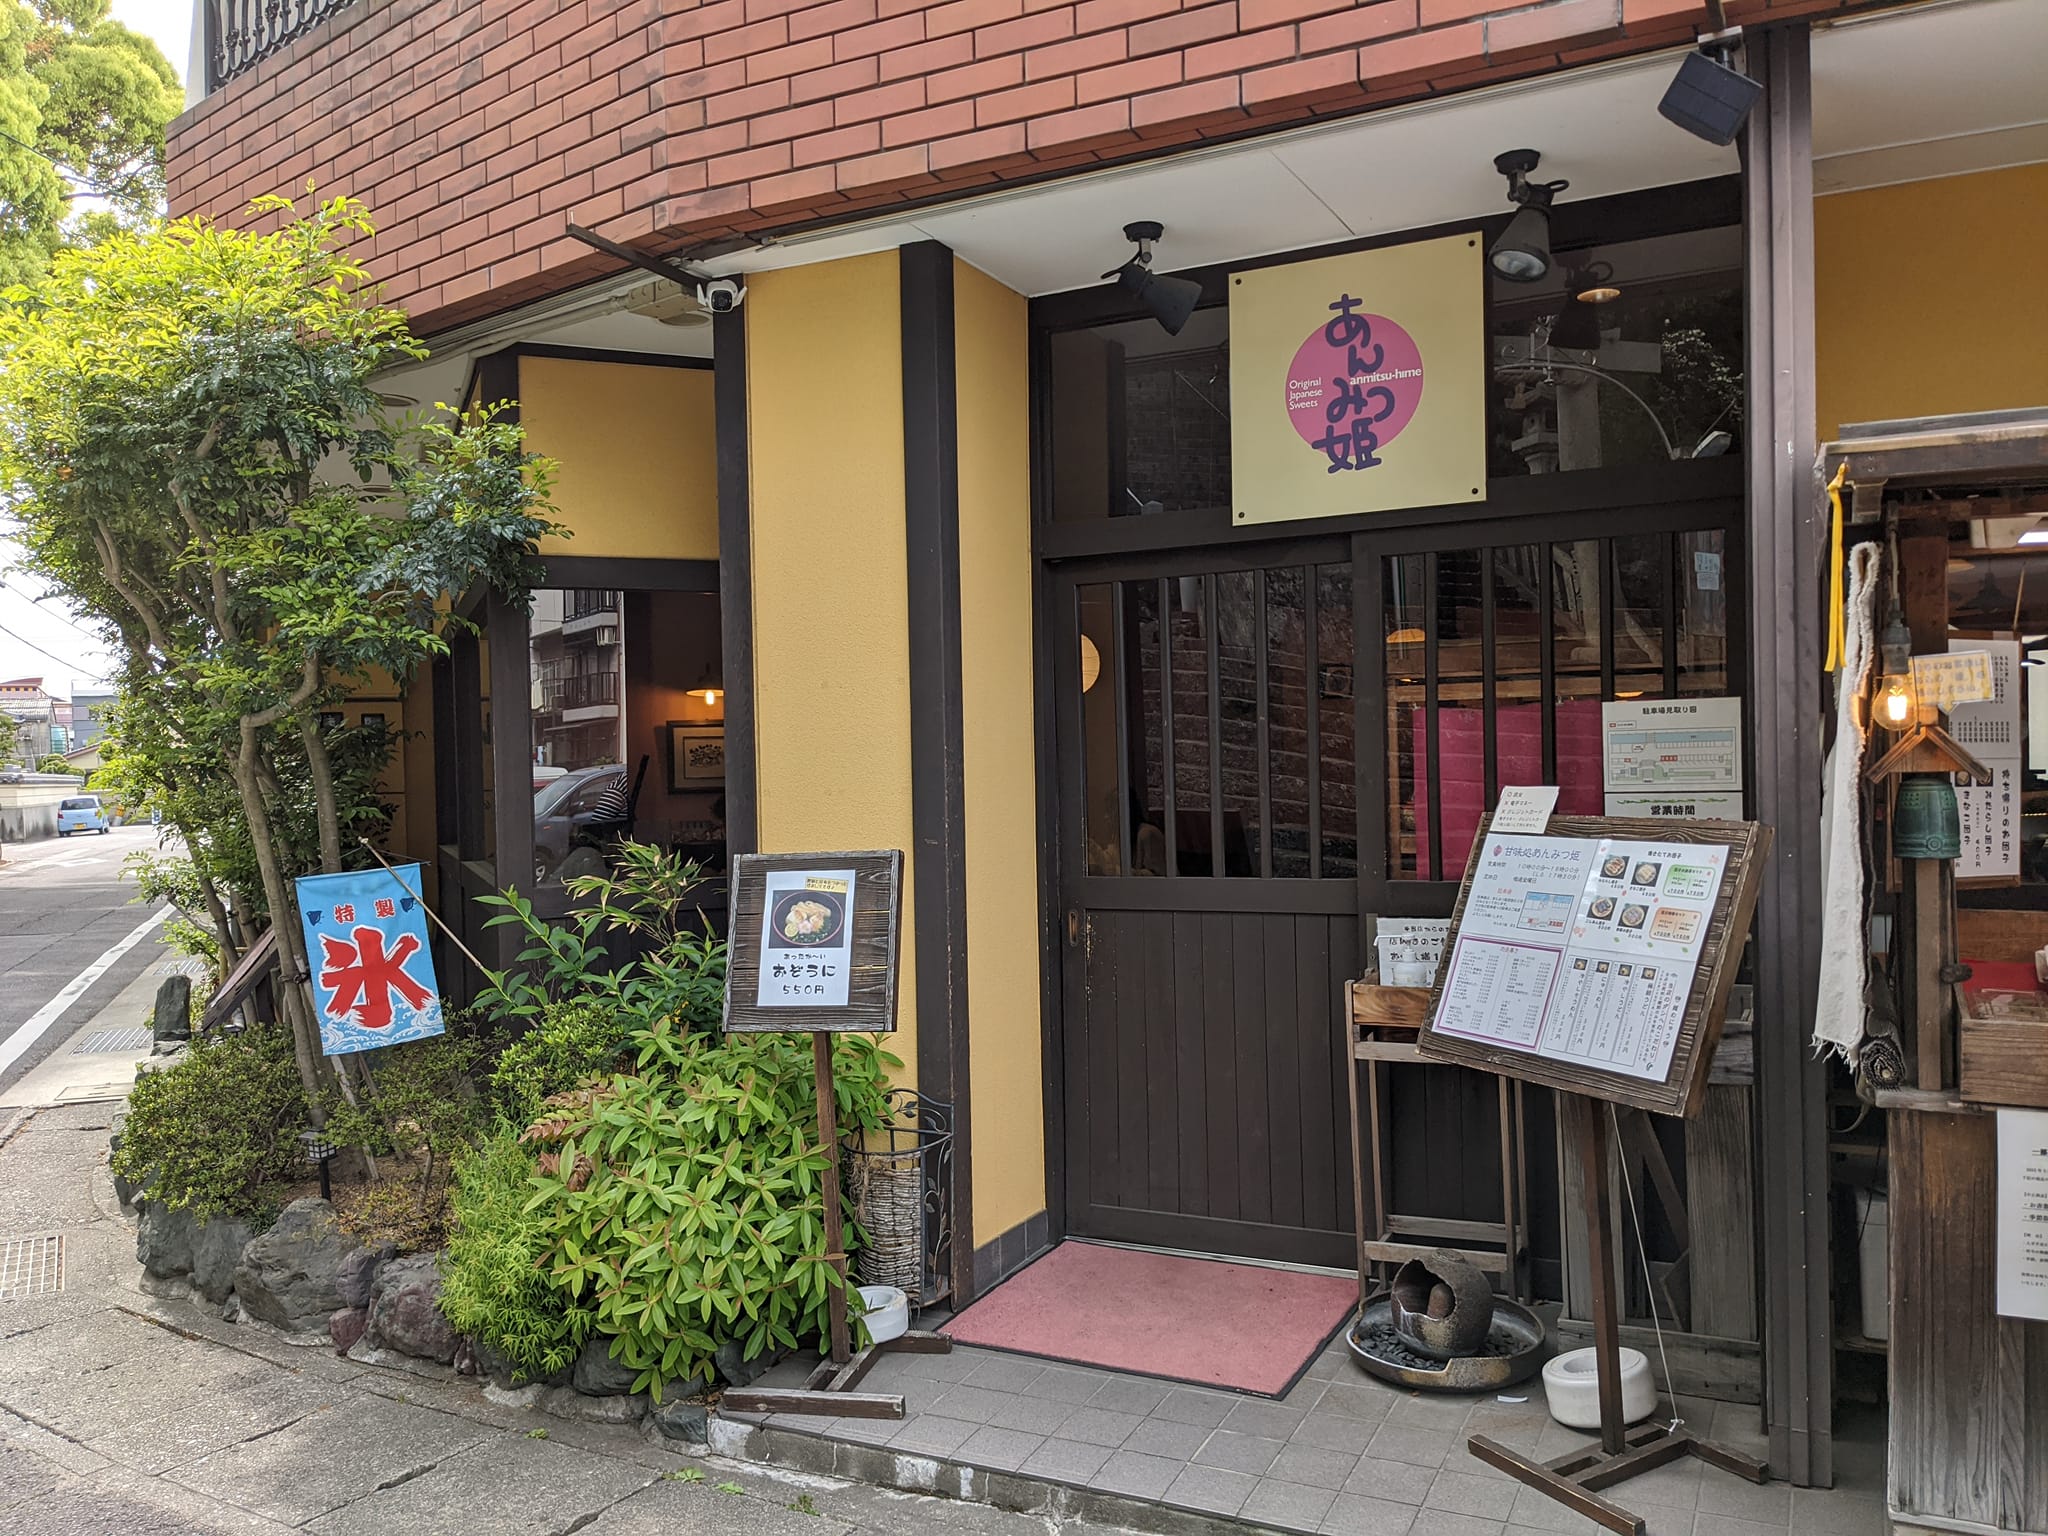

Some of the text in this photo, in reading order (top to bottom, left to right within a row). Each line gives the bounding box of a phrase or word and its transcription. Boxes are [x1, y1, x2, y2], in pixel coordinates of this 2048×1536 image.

[1289, 377, 1322, 391] Original
[1312, 293, 1395, 474] あんみつ姫
[1350, 367, 1422, 386] anmitsu-hime
[1289, 389, 1323, 402] Japanese
[1289, 400, 1318, 410] Sweets
[1651, 805, 1695, 816] 営業時間
[334, 898, 395, 924] 特製
[318, 925, 437, 1031] 氷
[772, 963, 837, 978] おぞうに
